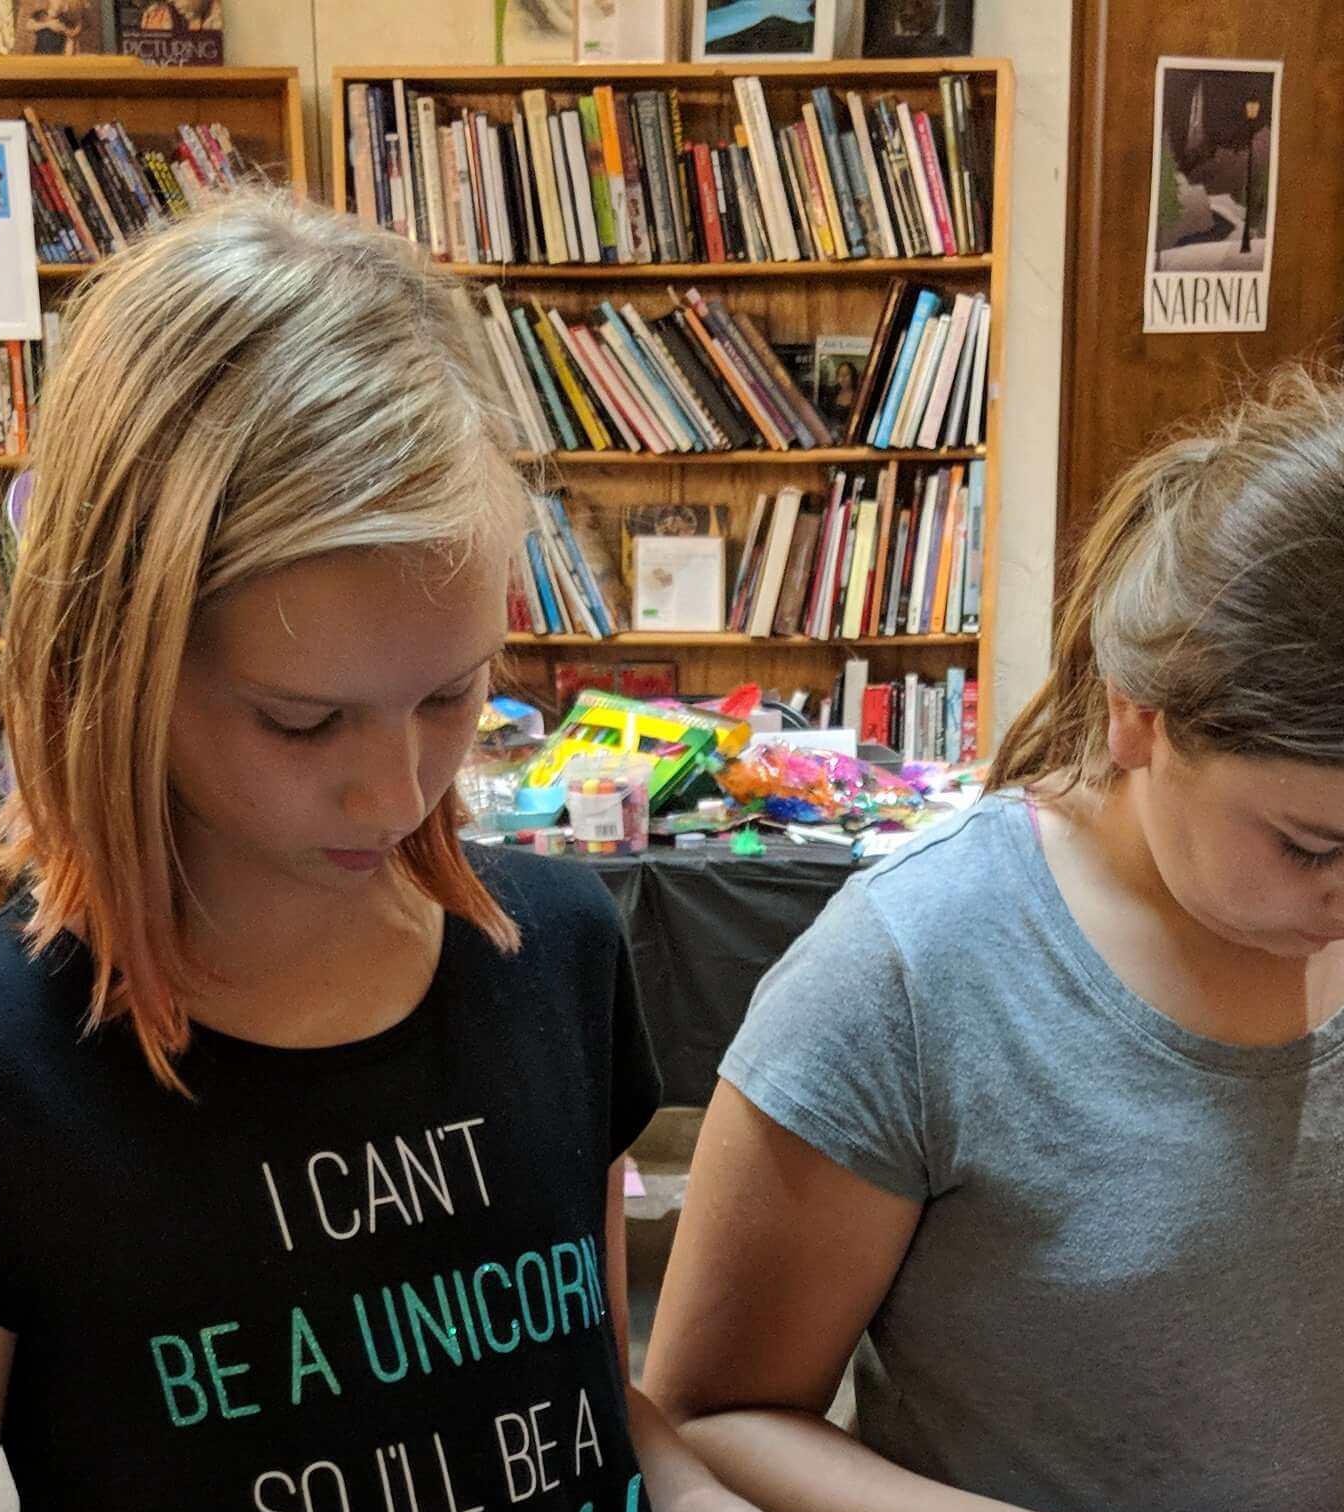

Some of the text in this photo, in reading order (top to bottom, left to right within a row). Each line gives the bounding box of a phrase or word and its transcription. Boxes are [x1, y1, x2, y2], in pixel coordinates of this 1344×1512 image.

[123, 39, 218, 60] PICTURING
[1150, 277, 1261, 326] NARNIA
[263, 1117, 493, 1251] I CAN'T
[150, 1234, 607, 1427] BE A UNICORN
[495, 1411, 560, 1504] BE
[574, 1387, 604, 1477] A
